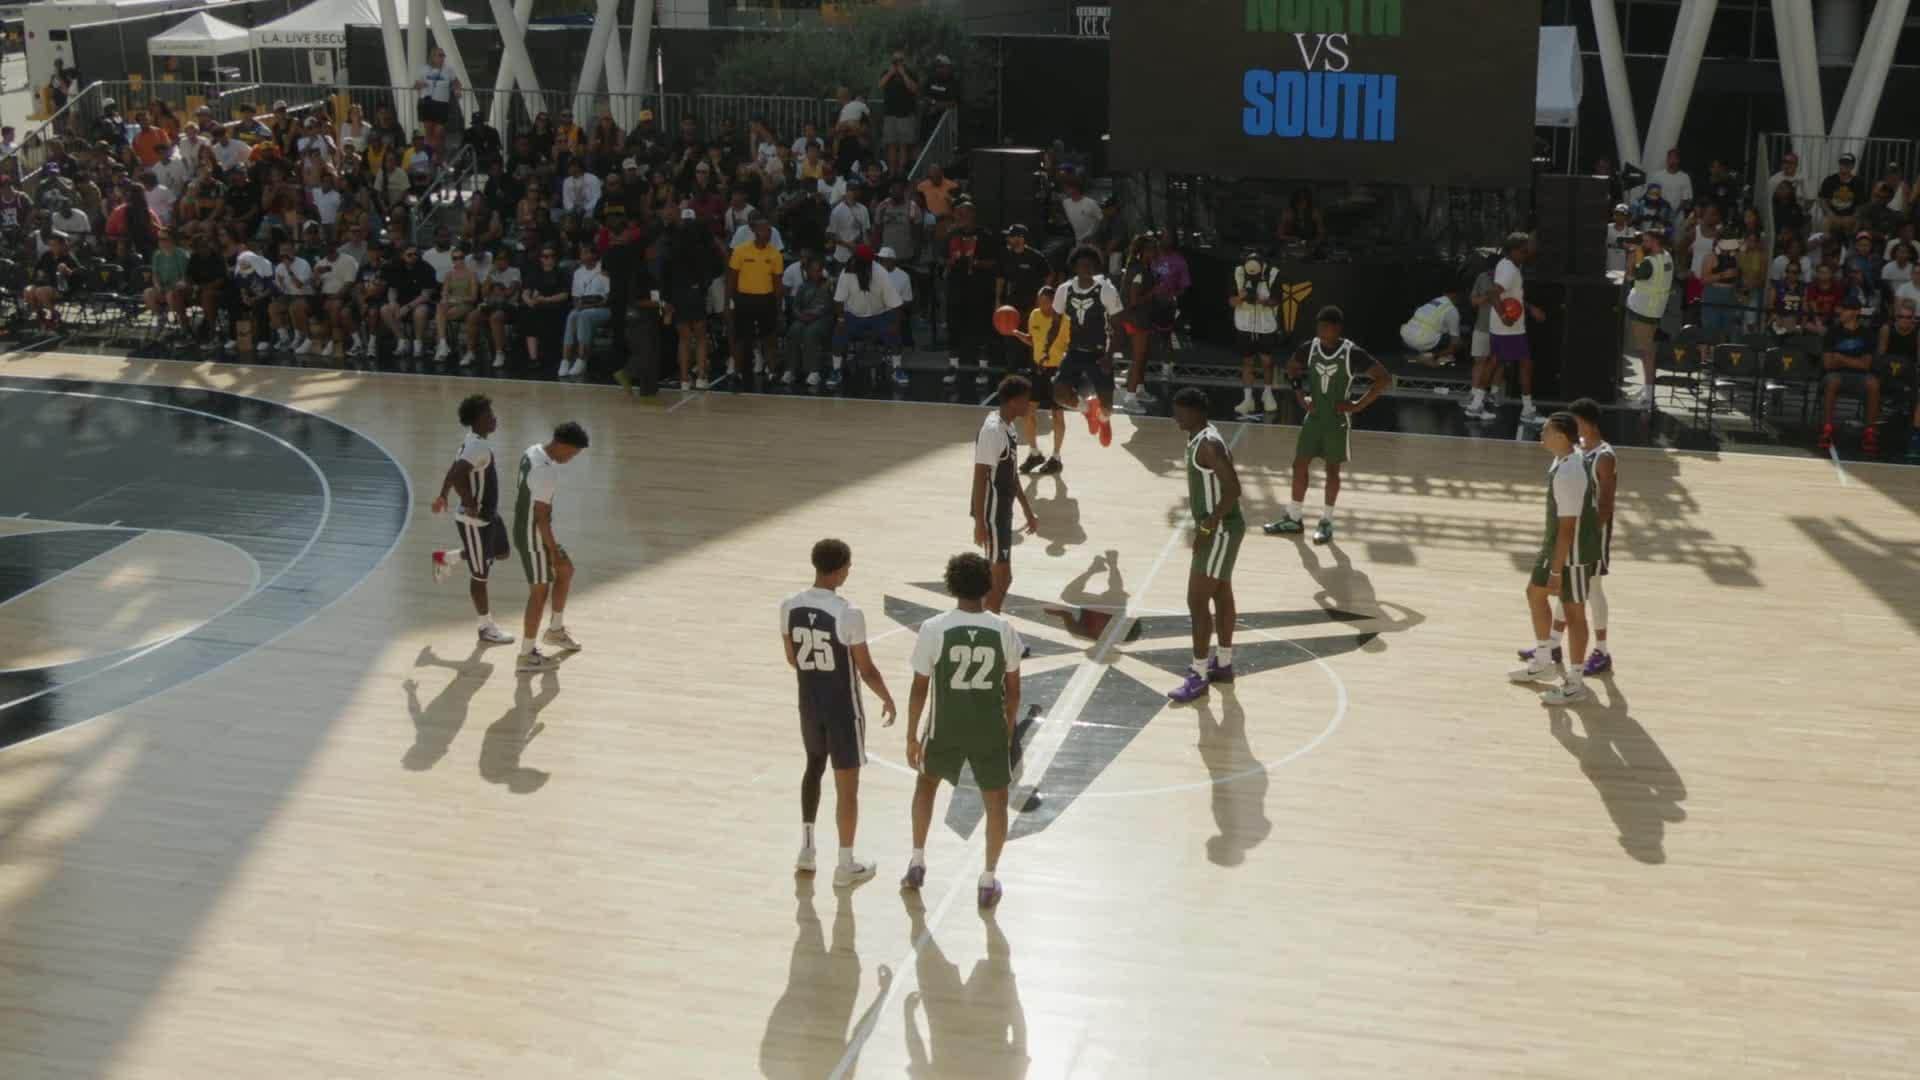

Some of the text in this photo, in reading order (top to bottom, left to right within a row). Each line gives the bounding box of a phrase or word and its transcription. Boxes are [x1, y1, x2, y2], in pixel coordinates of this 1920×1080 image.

[262, 33, 282, 44] L.A.
[286, 33, 311, 44] LIVE
[1078, 16, 1099, 35] ICE
[1293, 32, 1350, 73] VS
[1242, 68, 1398, 142] SOUTH
[792, 626, 836, 672] 25
[949, 644, 996, 690] 22
